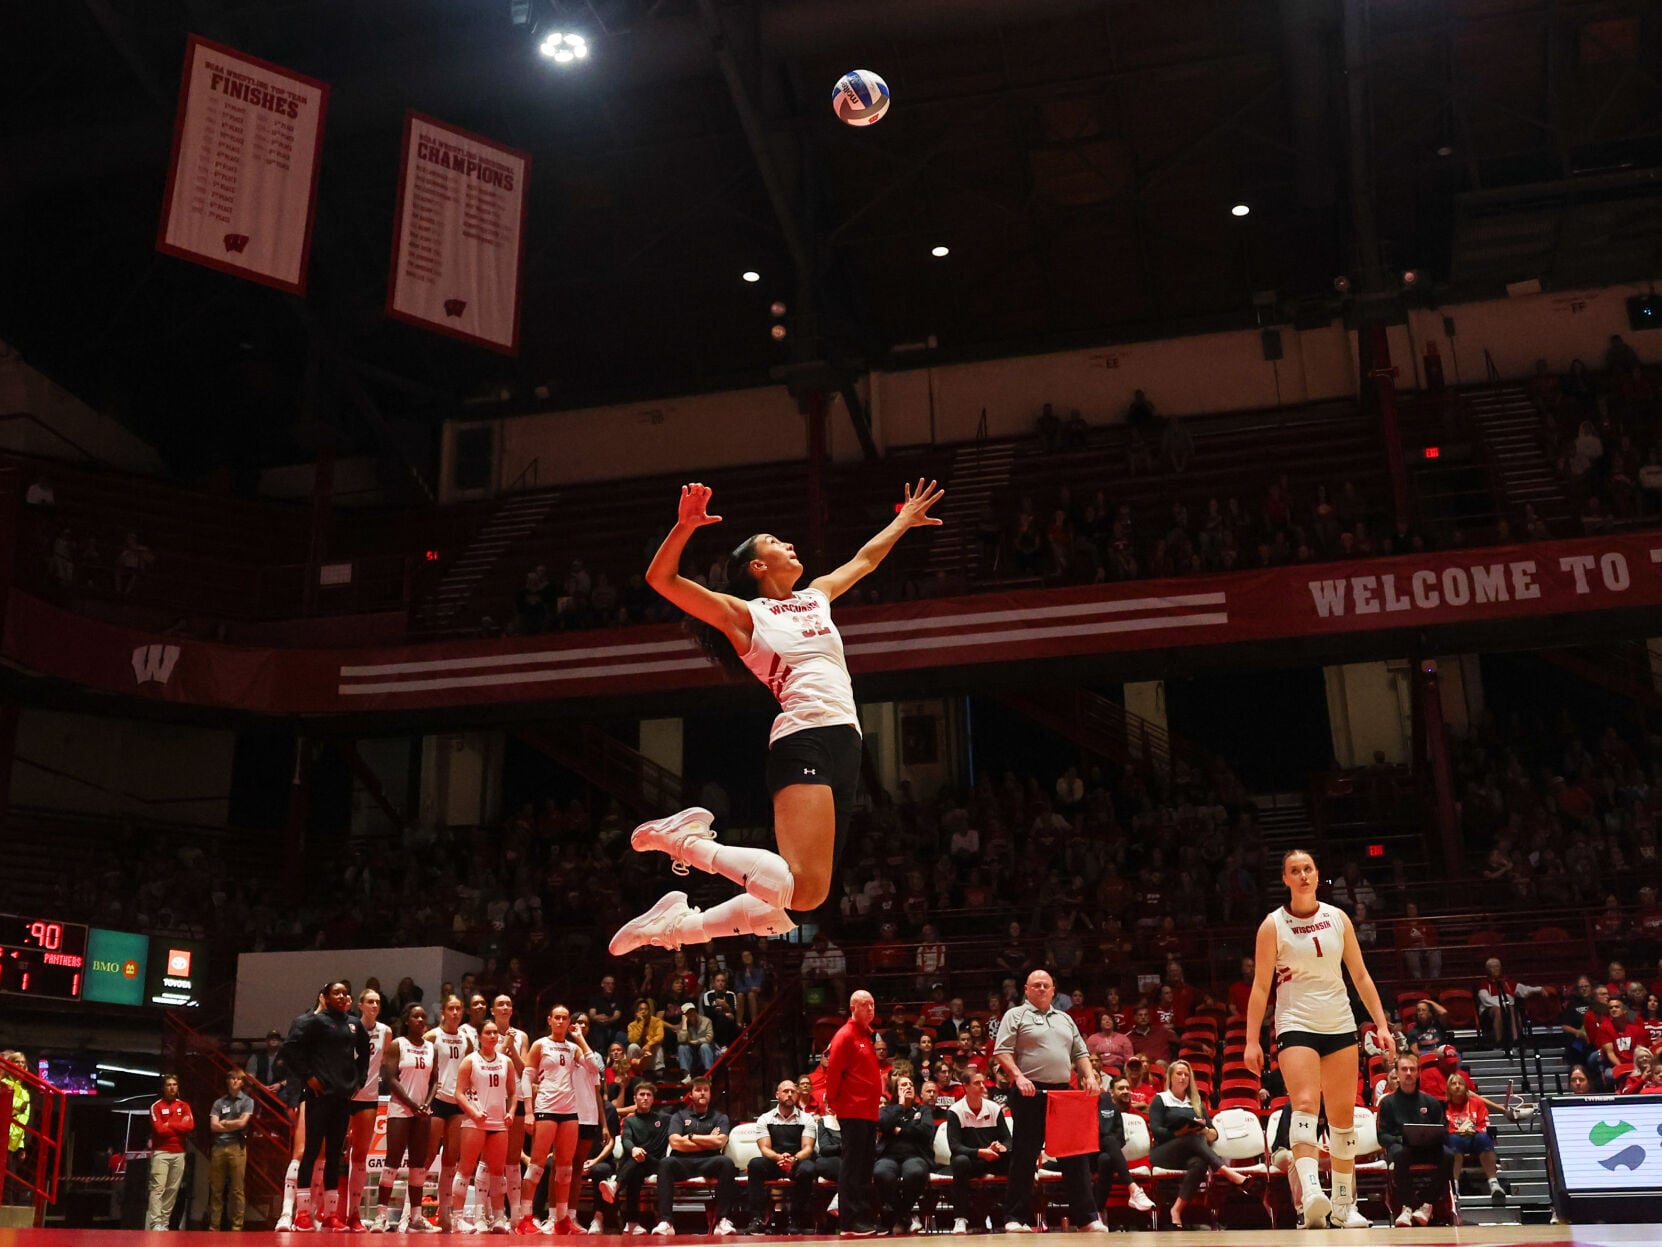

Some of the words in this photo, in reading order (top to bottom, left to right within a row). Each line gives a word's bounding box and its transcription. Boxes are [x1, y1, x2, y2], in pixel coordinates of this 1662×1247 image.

[210, 72, 299, 120] FINISHES
[417, 141, 514, 192] CHAMPIONS
[1308, 560, 1541, 617] WELCOME
[1559, 553, 1631, 594] TO
[1291, 920, 1332, 935] WISCONSIN
[1312, 936, 1323, 957] 1
[44, 952, 82, 968] PANTHERS
[92, 960, 119, 973] BMO
[22, 972, 29, 991] 1
[71, 973, 80, 996] 1
[163, 978, 192, 989] TOYOTA
[449, 1046, 459, 1060] 10
[559, 1054, 566, 1067] 8
[414, 1056, 426, 1070] 16
[488, 1073, 499, 1088] 18
